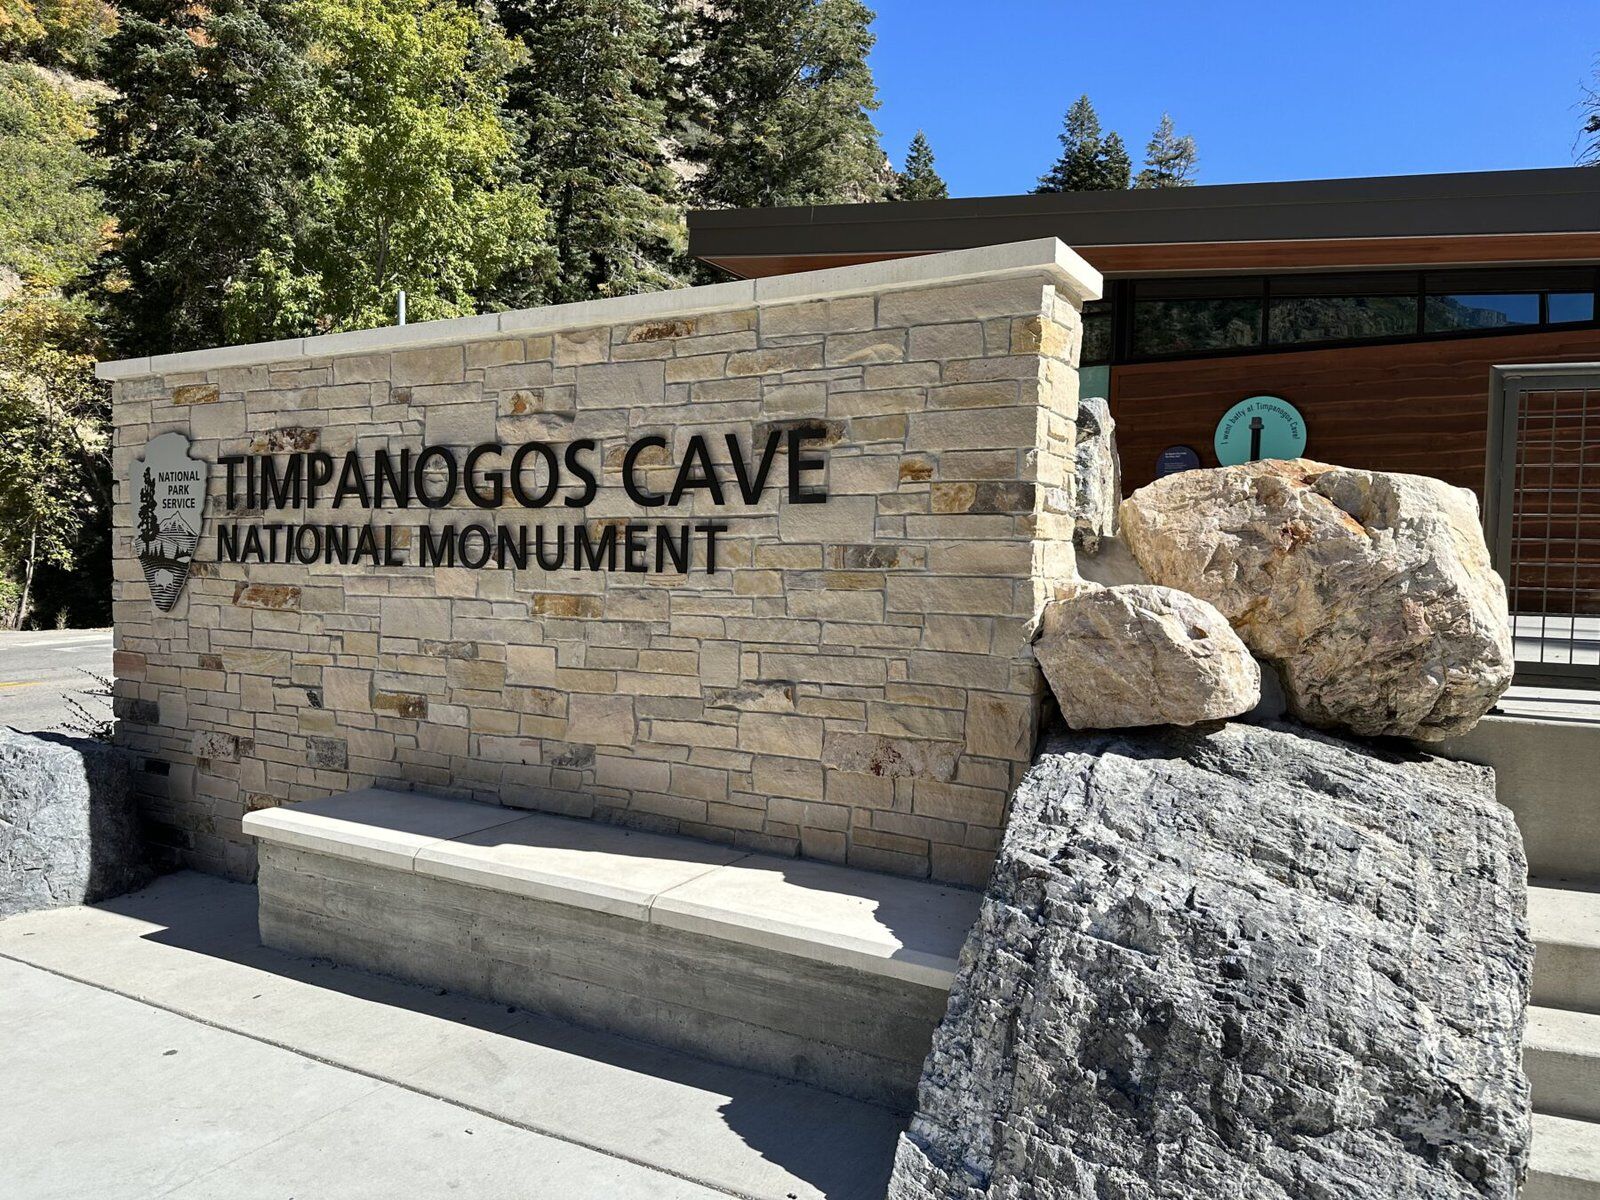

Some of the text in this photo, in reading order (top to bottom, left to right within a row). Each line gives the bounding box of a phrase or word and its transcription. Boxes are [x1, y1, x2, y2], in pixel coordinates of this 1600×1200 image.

[1223, 424, 1233, 440] went
[1229, 410, 1246, 424] batty
[1246, 404, 1254, 413] at
[1256, 402, 1293, 422] Timpanogos
[1290, 422, 1301, 440] Cave!
[158, 470, 201, 482] NATIONAL
[217, 428, 827, 511] TIMPANOGOS CAVE
[167, 484, 190, 495] PARK
[162, 497, 196, 509] SERVICE
[216, 523, 728, 575] NATIONAL MONUMENT
